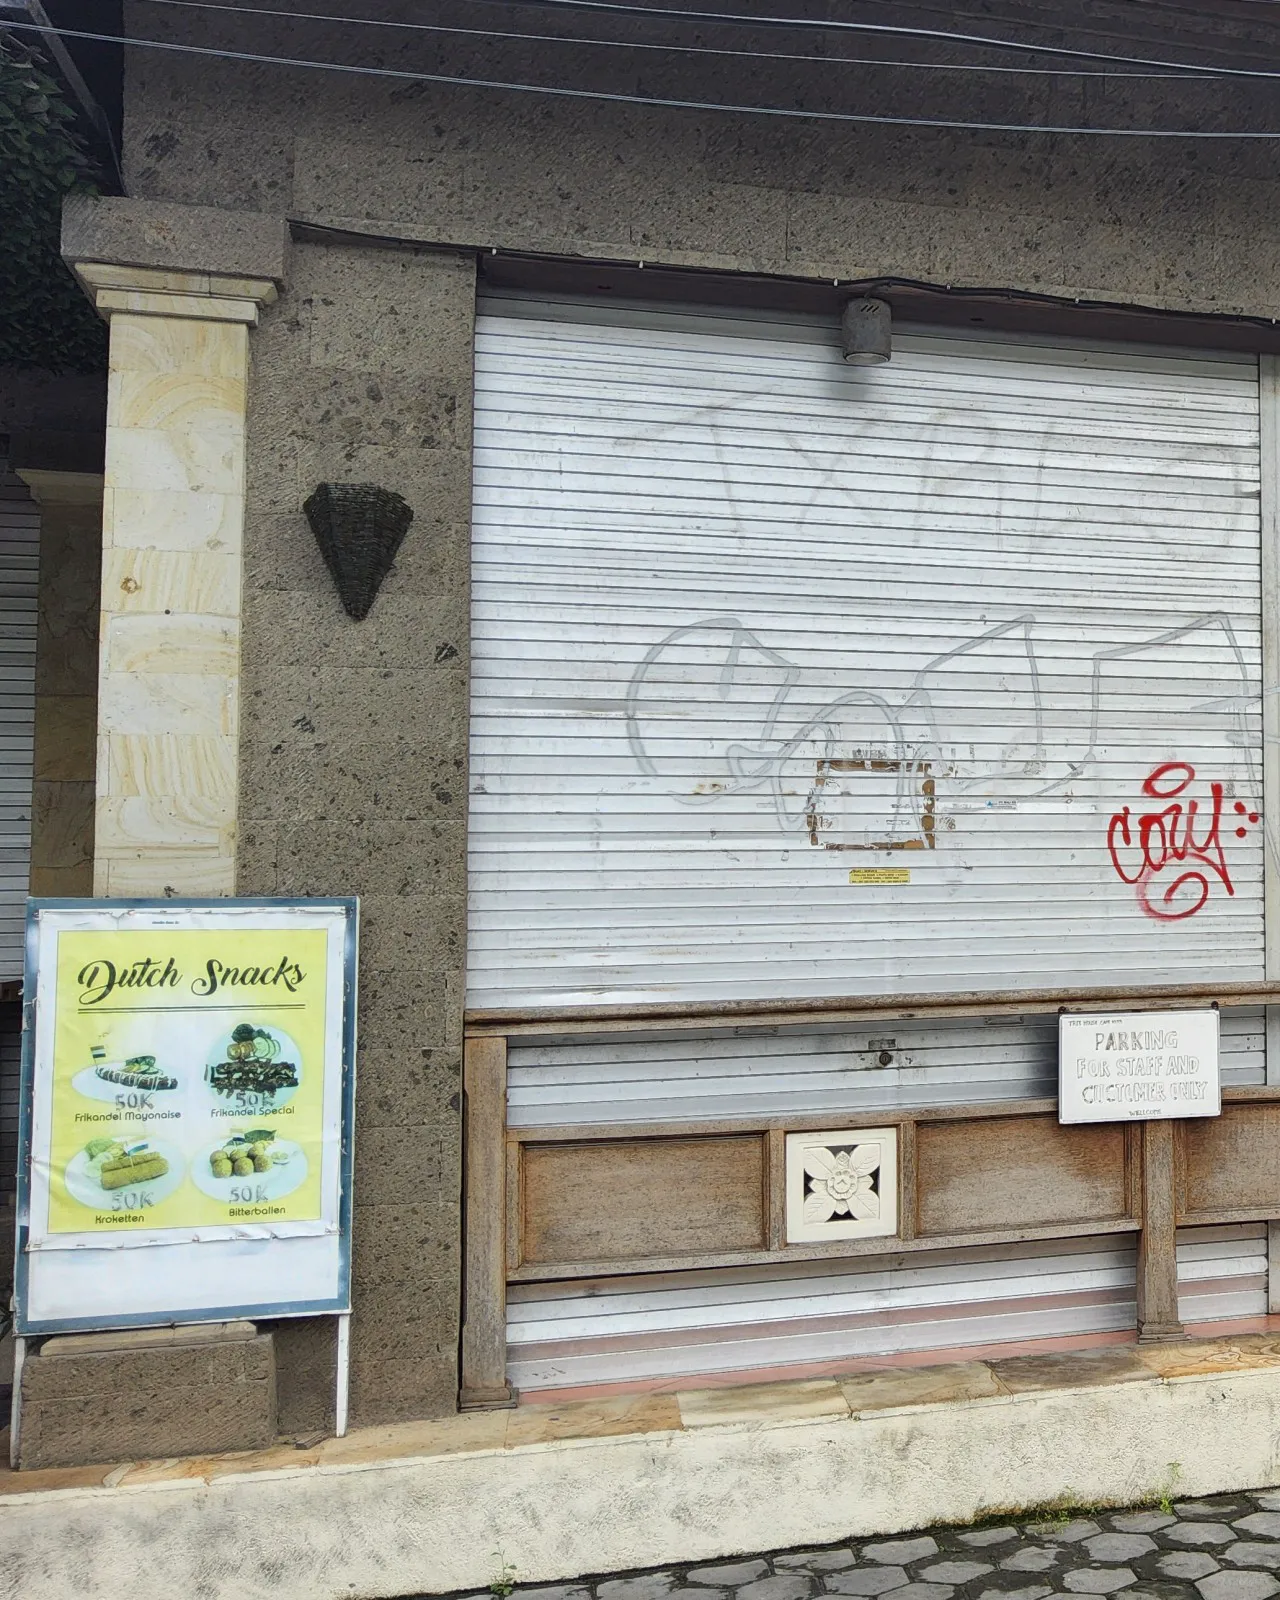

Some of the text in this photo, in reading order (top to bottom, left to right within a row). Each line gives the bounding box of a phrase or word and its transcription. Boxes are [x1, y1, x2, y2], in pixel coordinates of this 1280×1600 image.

[77, 956, 307, 1005] Dutch Snacks
[1096, 1030, 1178, 1050] PARKING
[1076, 1055, 1199, 1079] FOR STAFF AND
[1170, 1081, 1208, 1100] ONLY
[115, 1092, 154, 1110] 50K
[236, 1092, 274, 1108] 50K
[75, 1110, 181, 1122] Frikandel Mayonaise
[211, 1105, 295, 1118] Frikandel Special
[112, 1191, 154, 1211] 50K
[229, 1185, 268, 1204] 50K
[95, 1214, 144, 1224] Kroketten
[229, 1206, 286, 1217] Bitterballen
